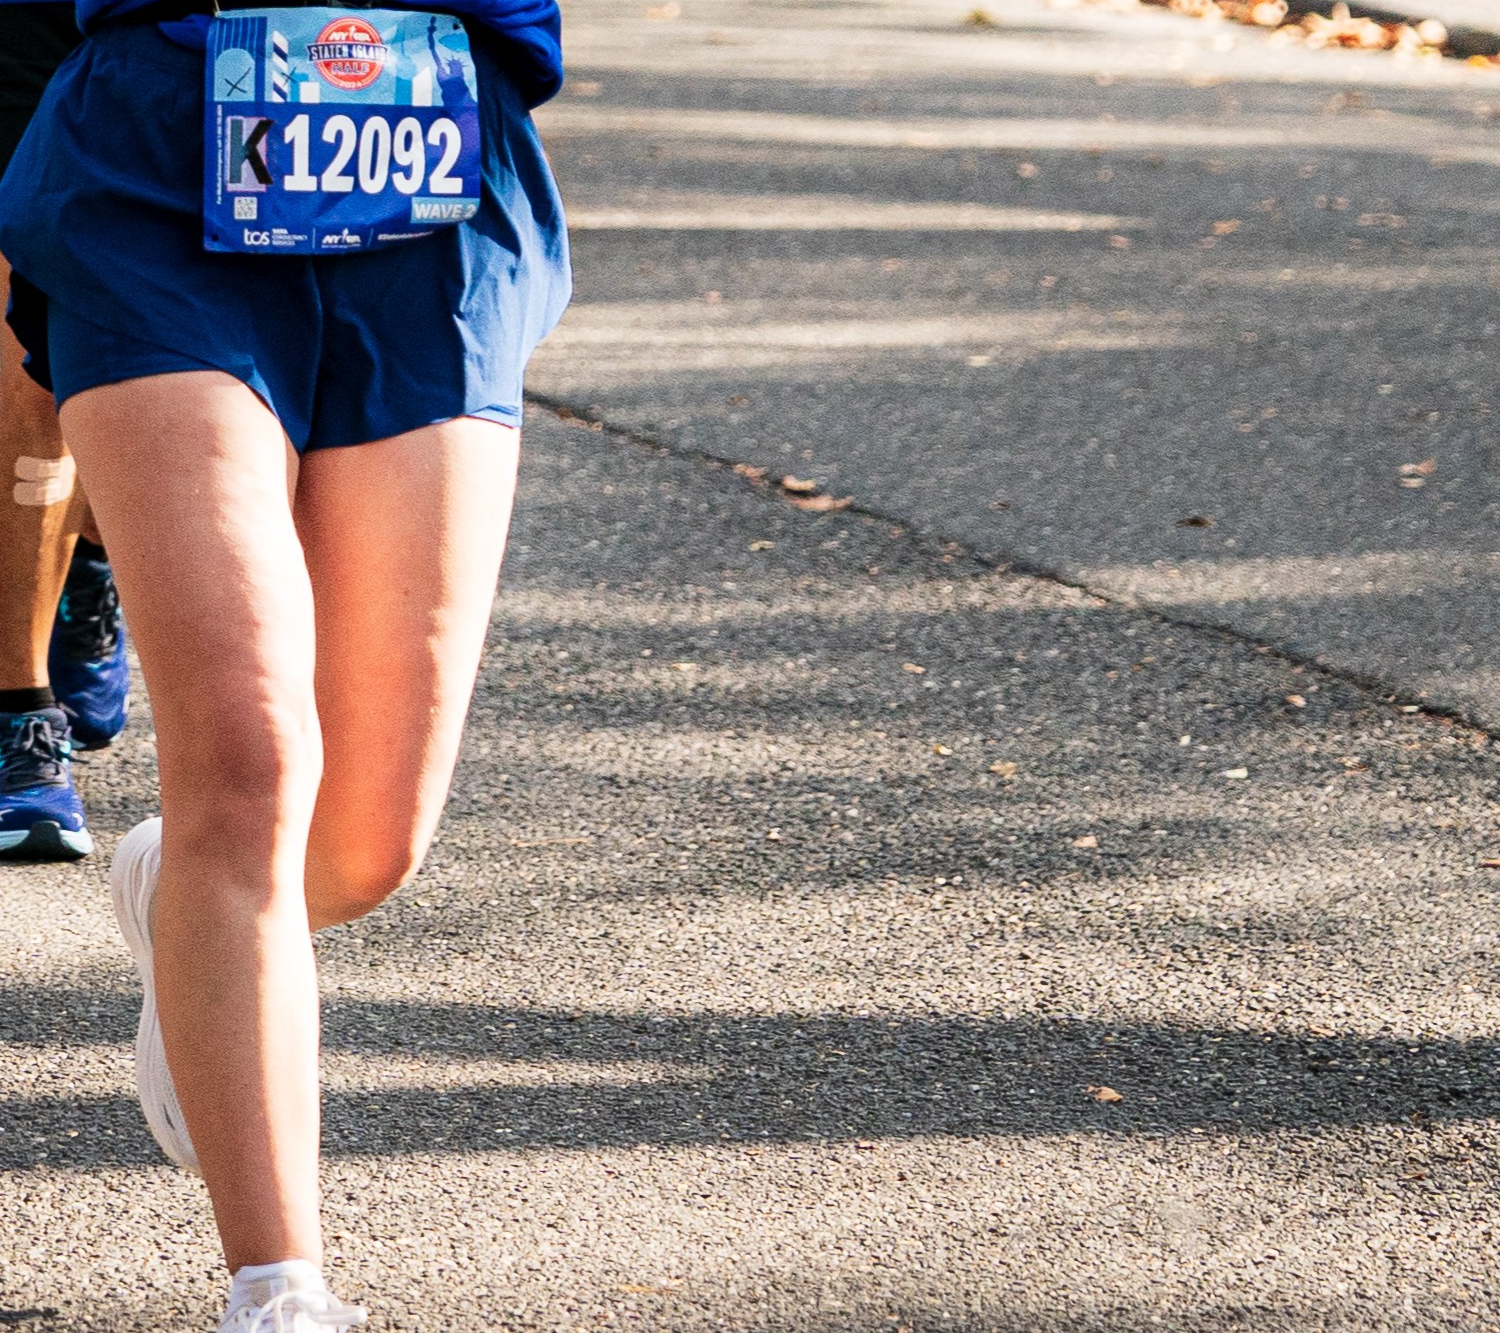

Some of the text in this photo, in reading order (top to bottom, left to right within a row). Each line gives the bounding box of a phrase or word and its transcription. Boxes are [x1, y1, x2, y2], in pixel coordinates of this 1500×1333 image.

[310, 44, 348, 61] STATEN
[331, 62, 370, 74] HALF
[229, 118, 276, 185] K
[283, 113, 463, 195] 12092
[414, 203, 476, 219] WAVE 2
